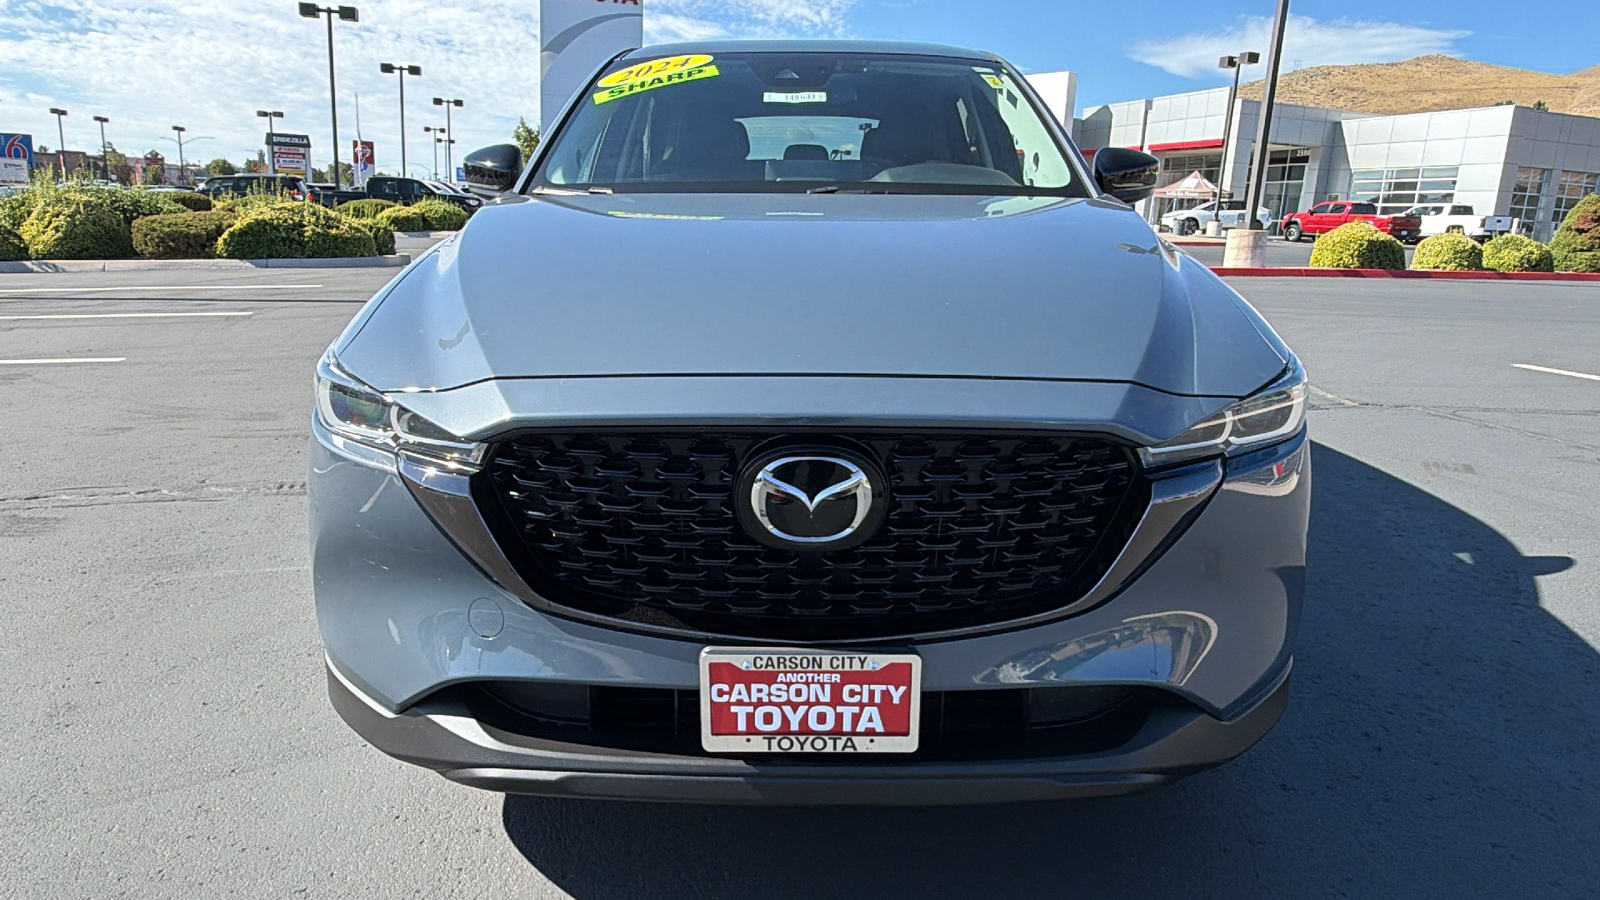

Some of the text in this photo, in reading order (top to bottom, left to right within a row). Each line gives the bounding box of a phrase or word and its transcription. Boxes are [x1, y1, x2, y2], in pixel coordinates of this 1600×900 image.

[615, 56, 692, 84] 2024
[608, 68, 705, 98] SHARP
[5, 134, 29, 160] 6
[752, 656, 868, 670] CARSON CITY
[776, 673, 841, 683] ANOTHER
[711, 683, 907, 705] CARSON CITY
[730, 705, 885, 733] TOYOTA
[762, 736, 858, 752] TOYOTA
